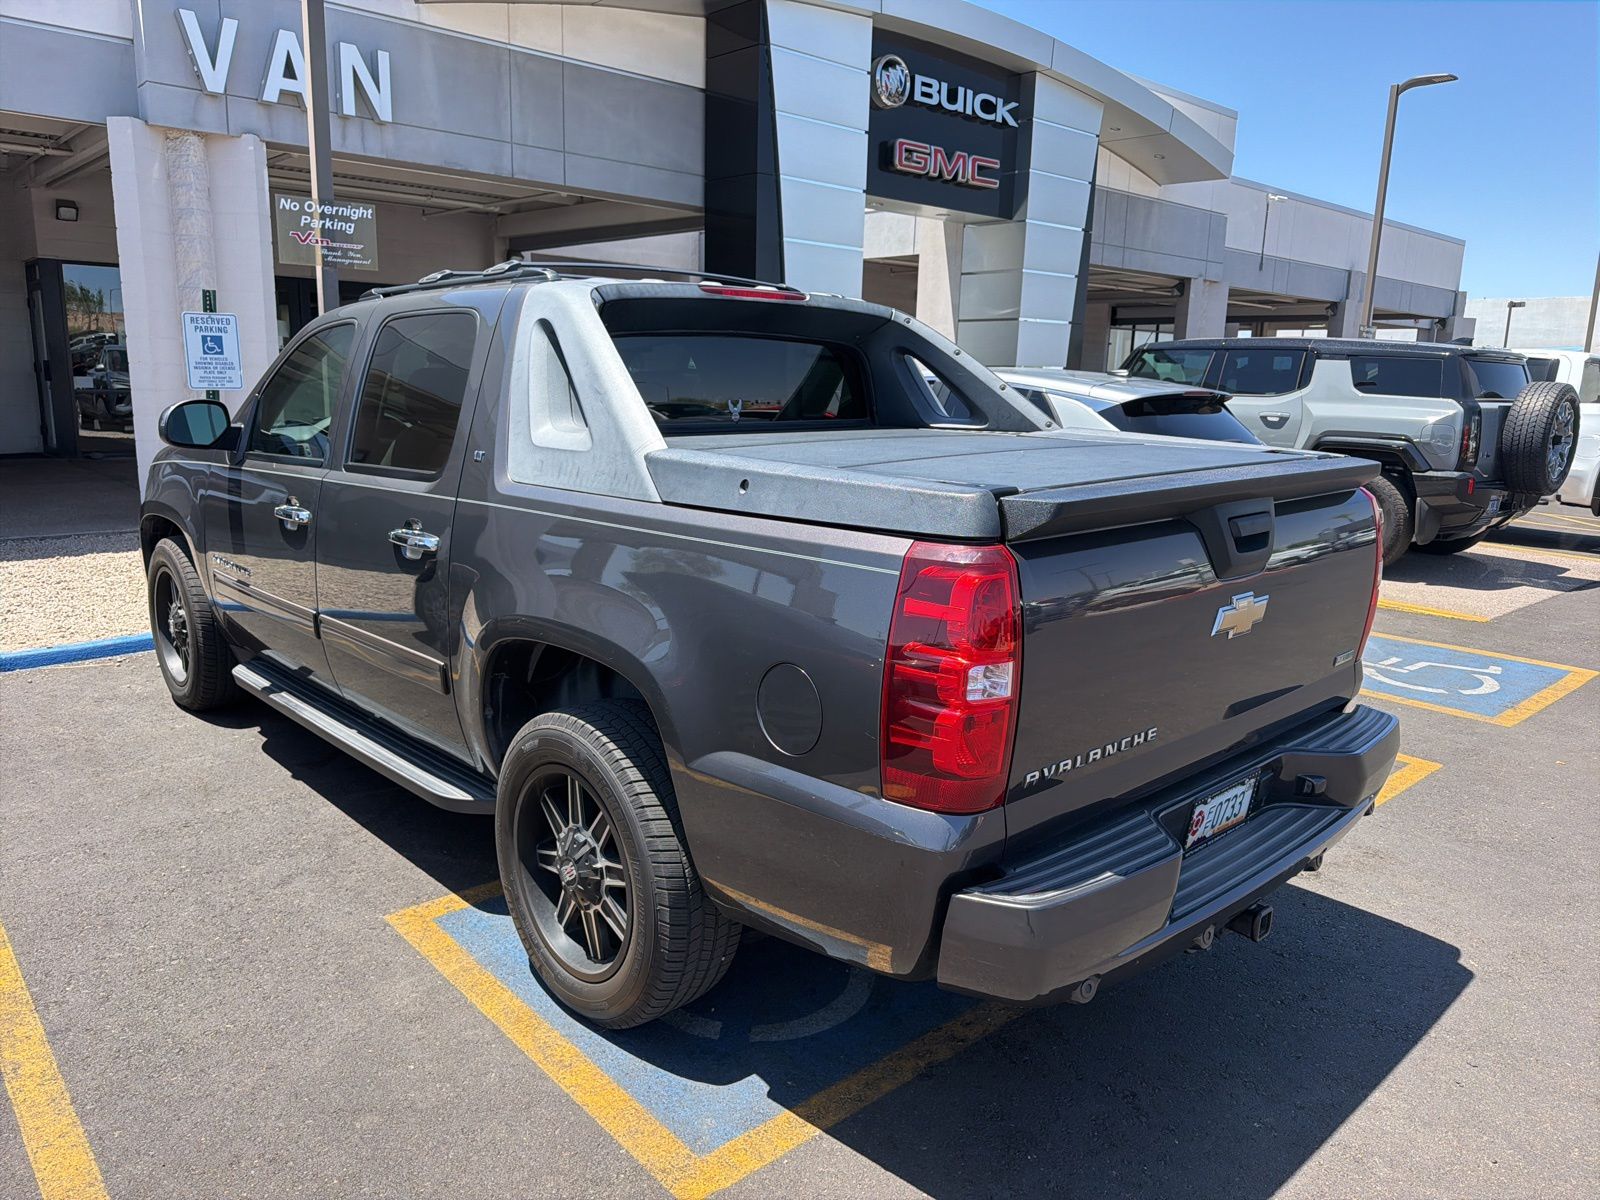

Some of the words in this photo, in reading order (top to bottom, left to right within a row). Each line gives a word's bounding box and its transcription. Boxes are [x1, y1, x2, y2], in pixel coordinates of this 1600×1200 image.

[178, 8, 393, 123] VAN
[914, 74, 1020, 128] BUICK
[894, 138, 1000, 189] GMC
[279, 198, 300, 211] No
[304, 200, 373, 220] Overnight
[300, 215, 355, 235] Parking
[190, 316, 231, 326] RESERVED
[194, 325, 228, 334] PARKING
[1024, 727, 1157, 789] AVALANCHE
